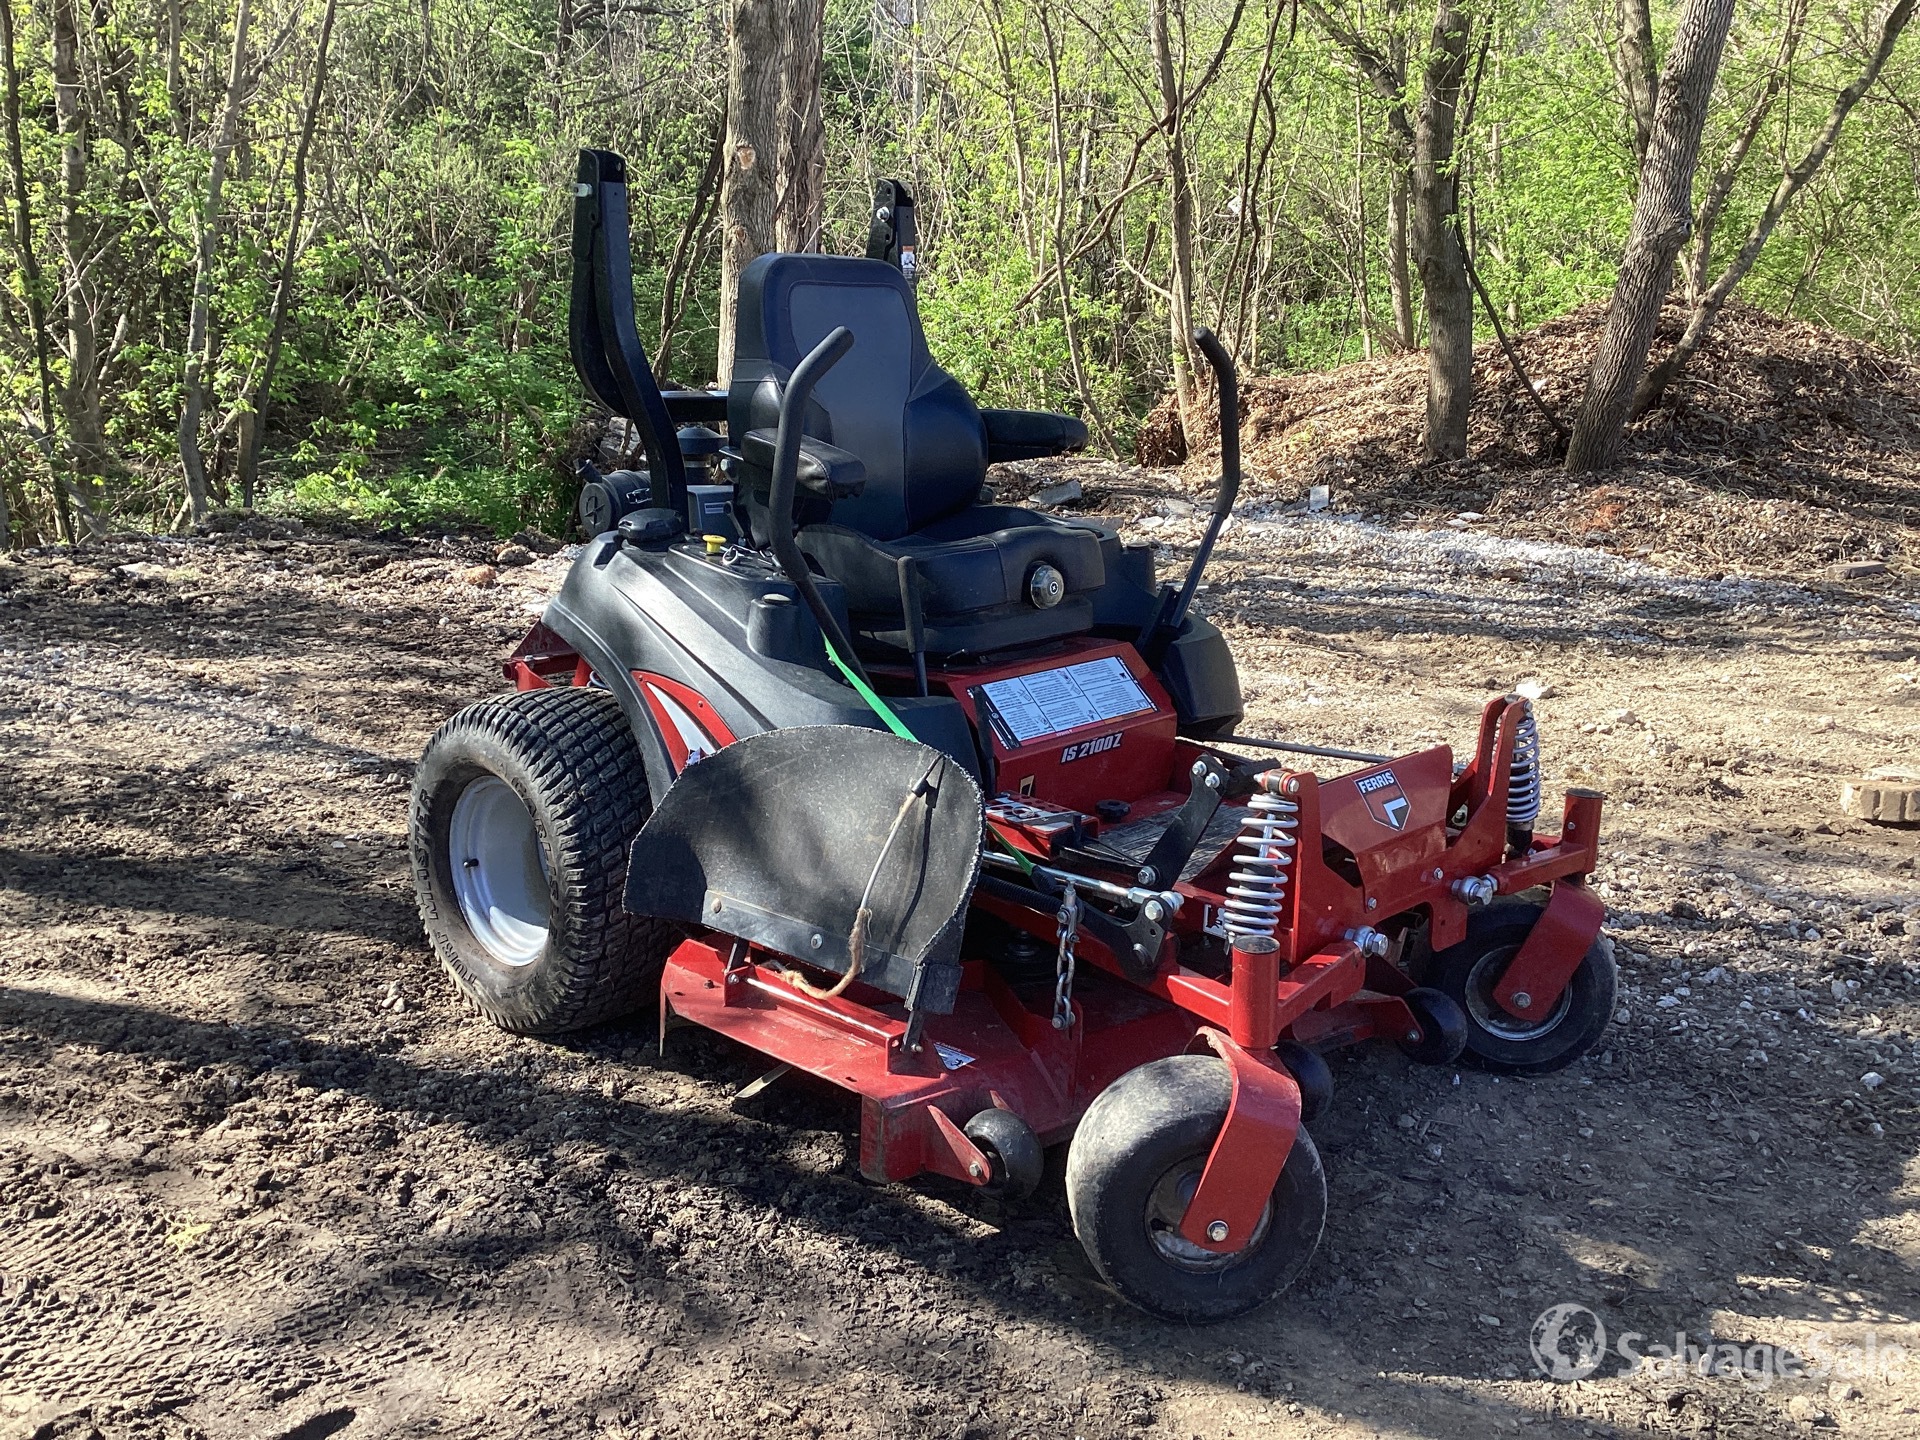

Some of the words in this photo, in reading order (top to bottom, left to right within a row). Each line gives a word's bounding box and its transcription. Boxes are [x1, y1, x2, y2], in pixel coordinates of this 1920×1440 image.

[1061, 746, 1078, 763] IS
[1078, 732, 1122, 758] 2100Z
[1358, 772, 1395, 794] FERRIS
